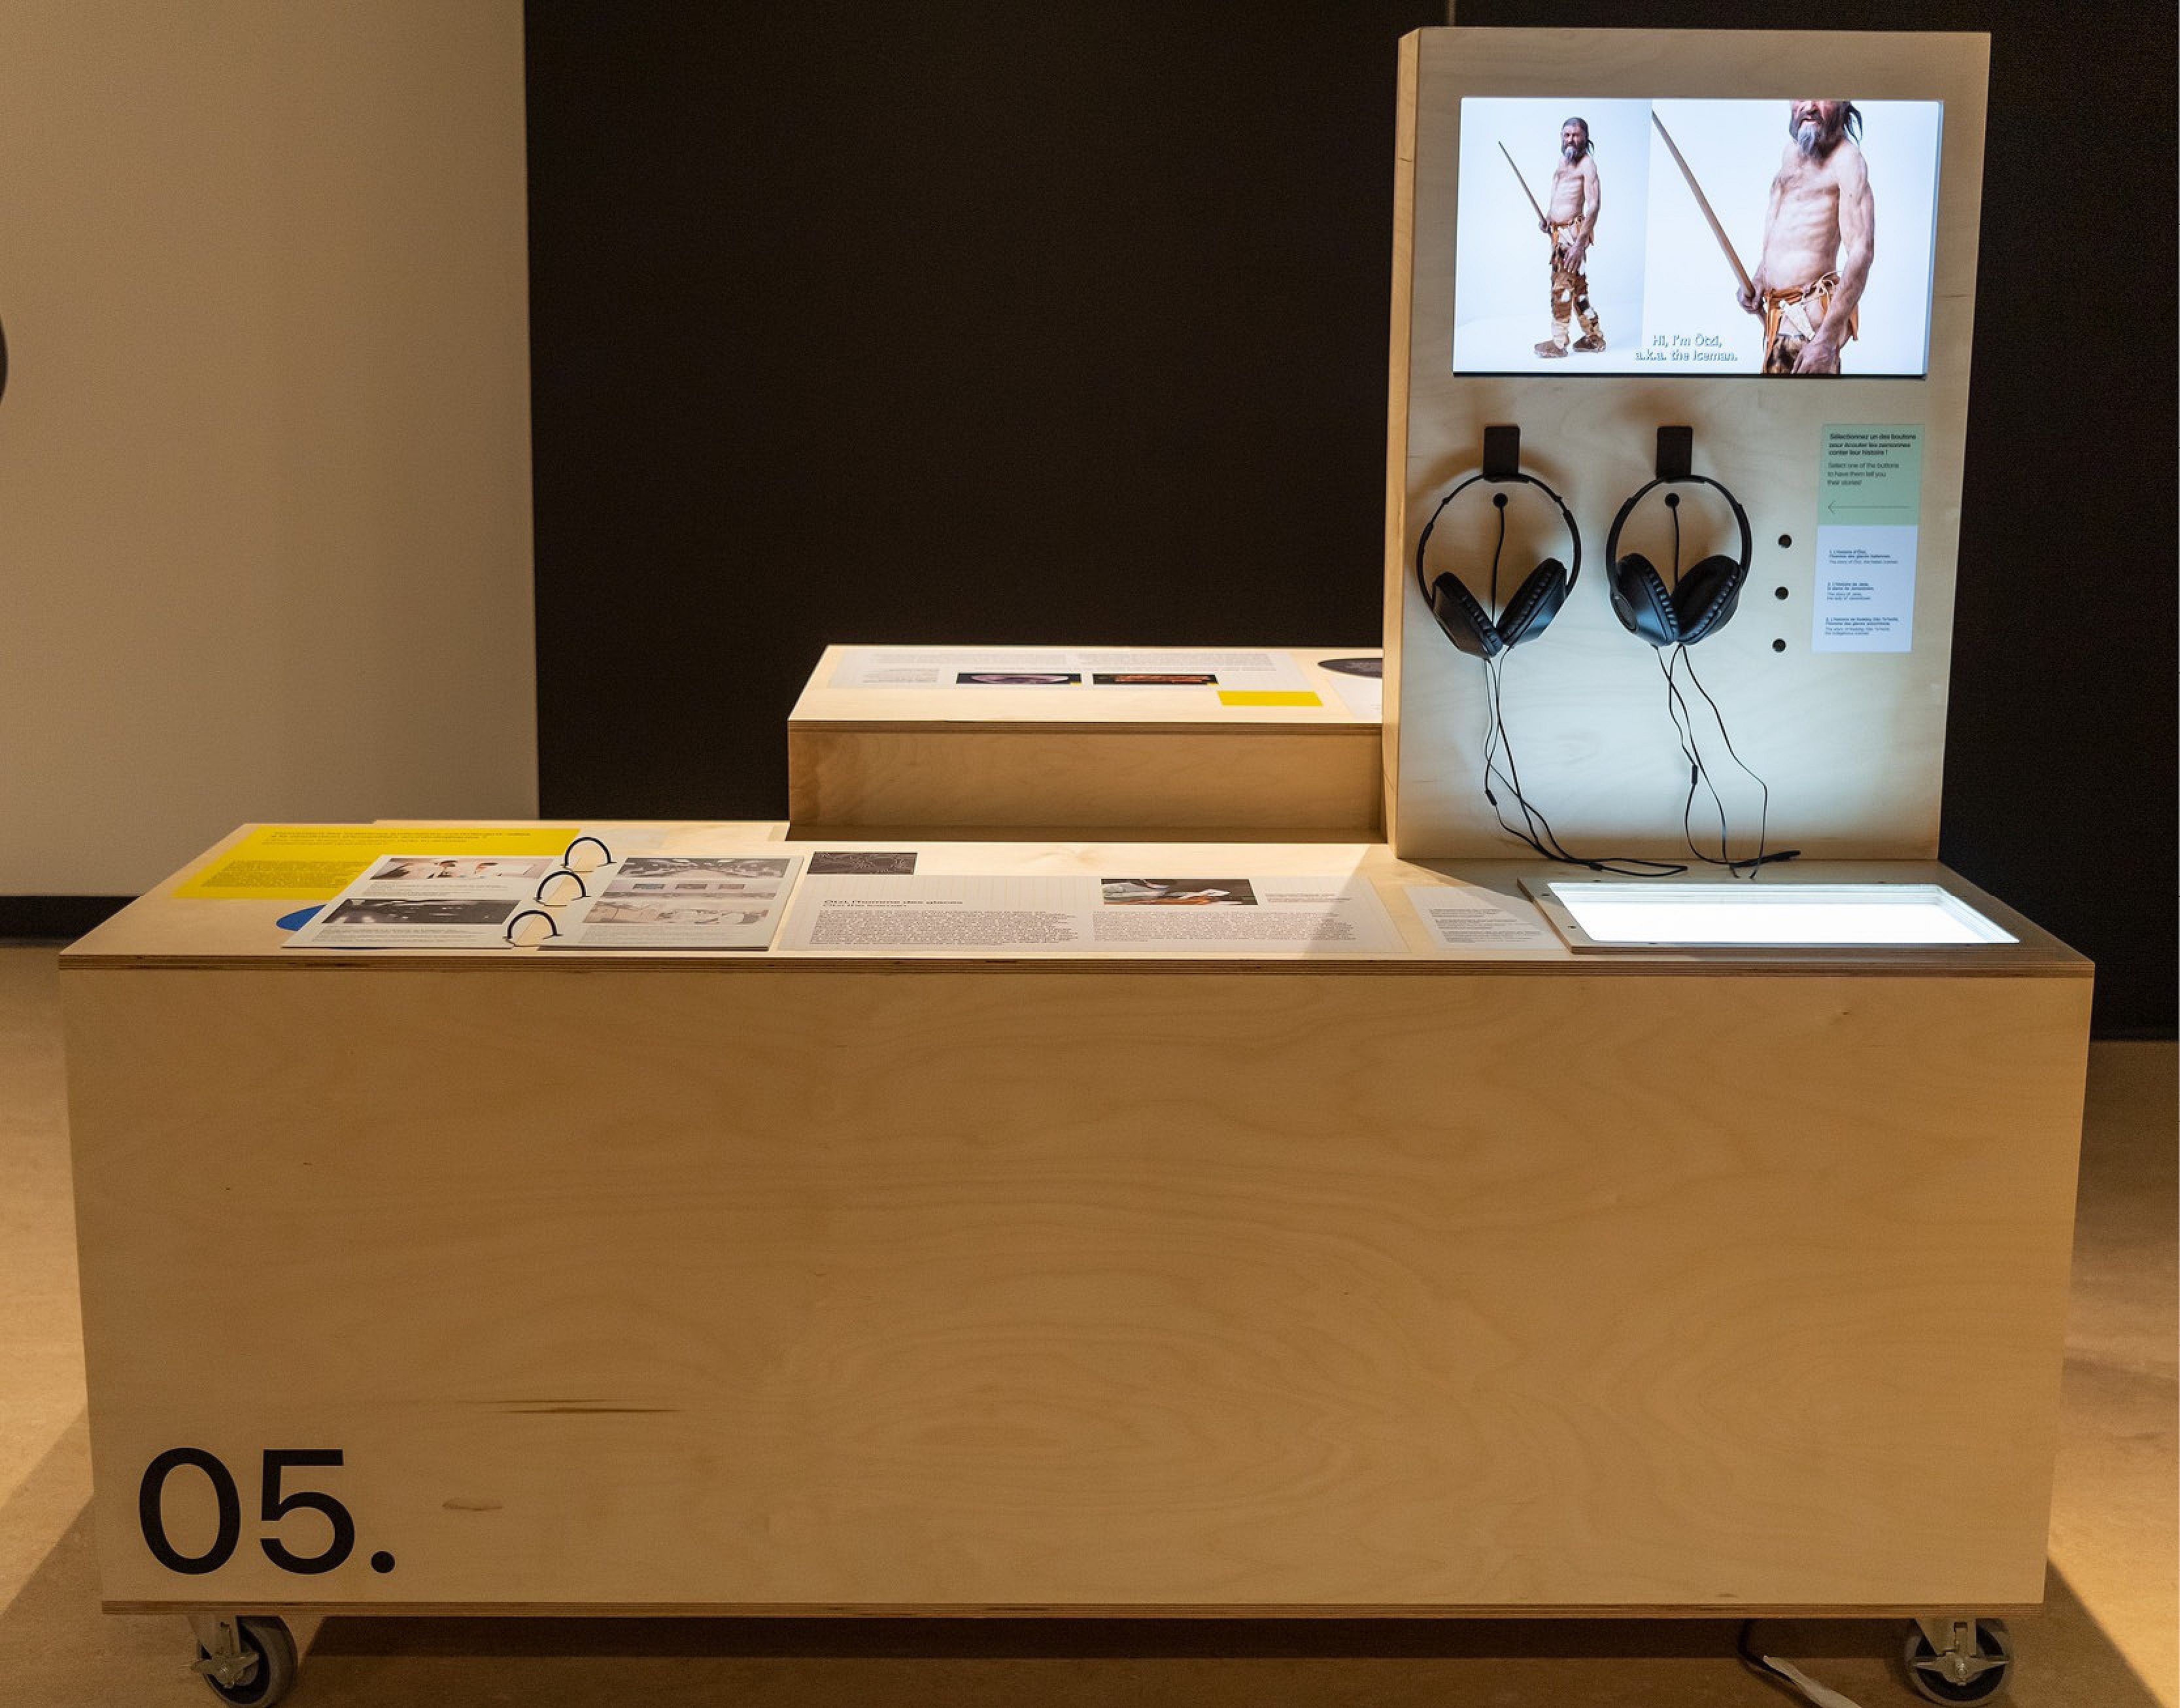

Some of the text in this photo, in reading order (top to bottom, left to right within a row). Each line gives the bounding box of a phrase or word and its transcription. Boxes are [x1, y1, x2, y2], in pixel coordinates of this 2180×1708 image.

[1652, 334, 1669, 348] Hi,
[1673, 334, 1692, 347] I'm
[1672, 349, 1690, 361] the
[139, 1447, 396, 1575] 05.
